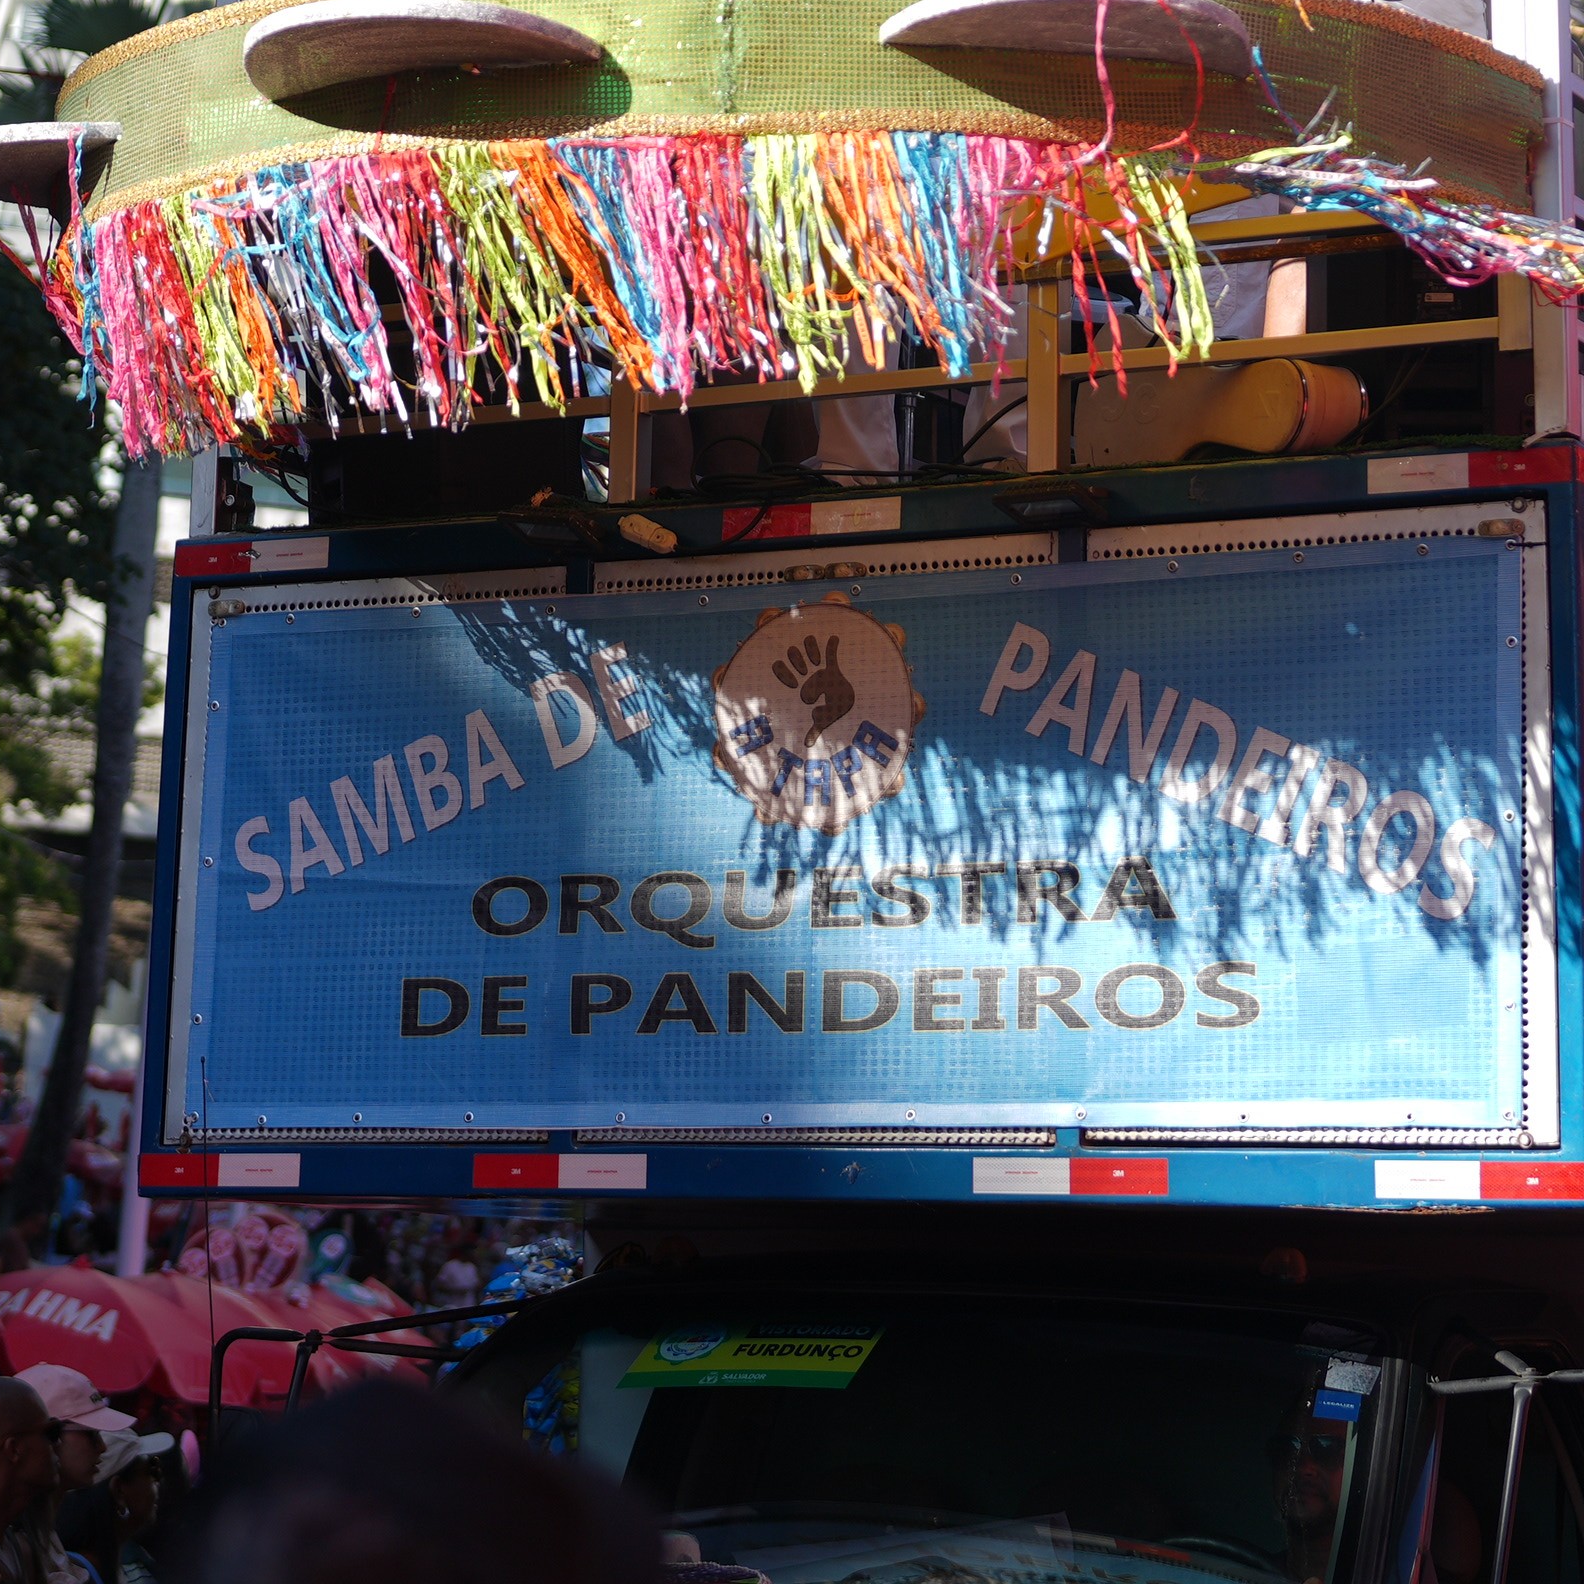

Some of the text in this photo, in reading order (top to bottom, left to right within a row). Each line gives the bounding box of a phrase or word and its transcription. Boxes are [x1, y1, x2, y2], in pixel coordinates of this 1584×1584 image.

[234, 640, 652, 912] SAMBA DE
[978, 621, 1496, 920] PANDEIROS
[471, 855, 1179, 950] ORQUESTRA
[400, 961, 1262, 1038] DE PANDEIROS
[174, 1166, 185, 1174] 3M
[510, 1167, 522, 1175] 3M
[1112, 1169, 1125, 1177] 3M
[1525, 1176, 1539, 1185] 3M
[756, 1322, 872, 1337] VISTORIADO
[732, 1343, 864, 1361] FURDUNÇO
[721, 1372, 767, 1381] SALVADOR
